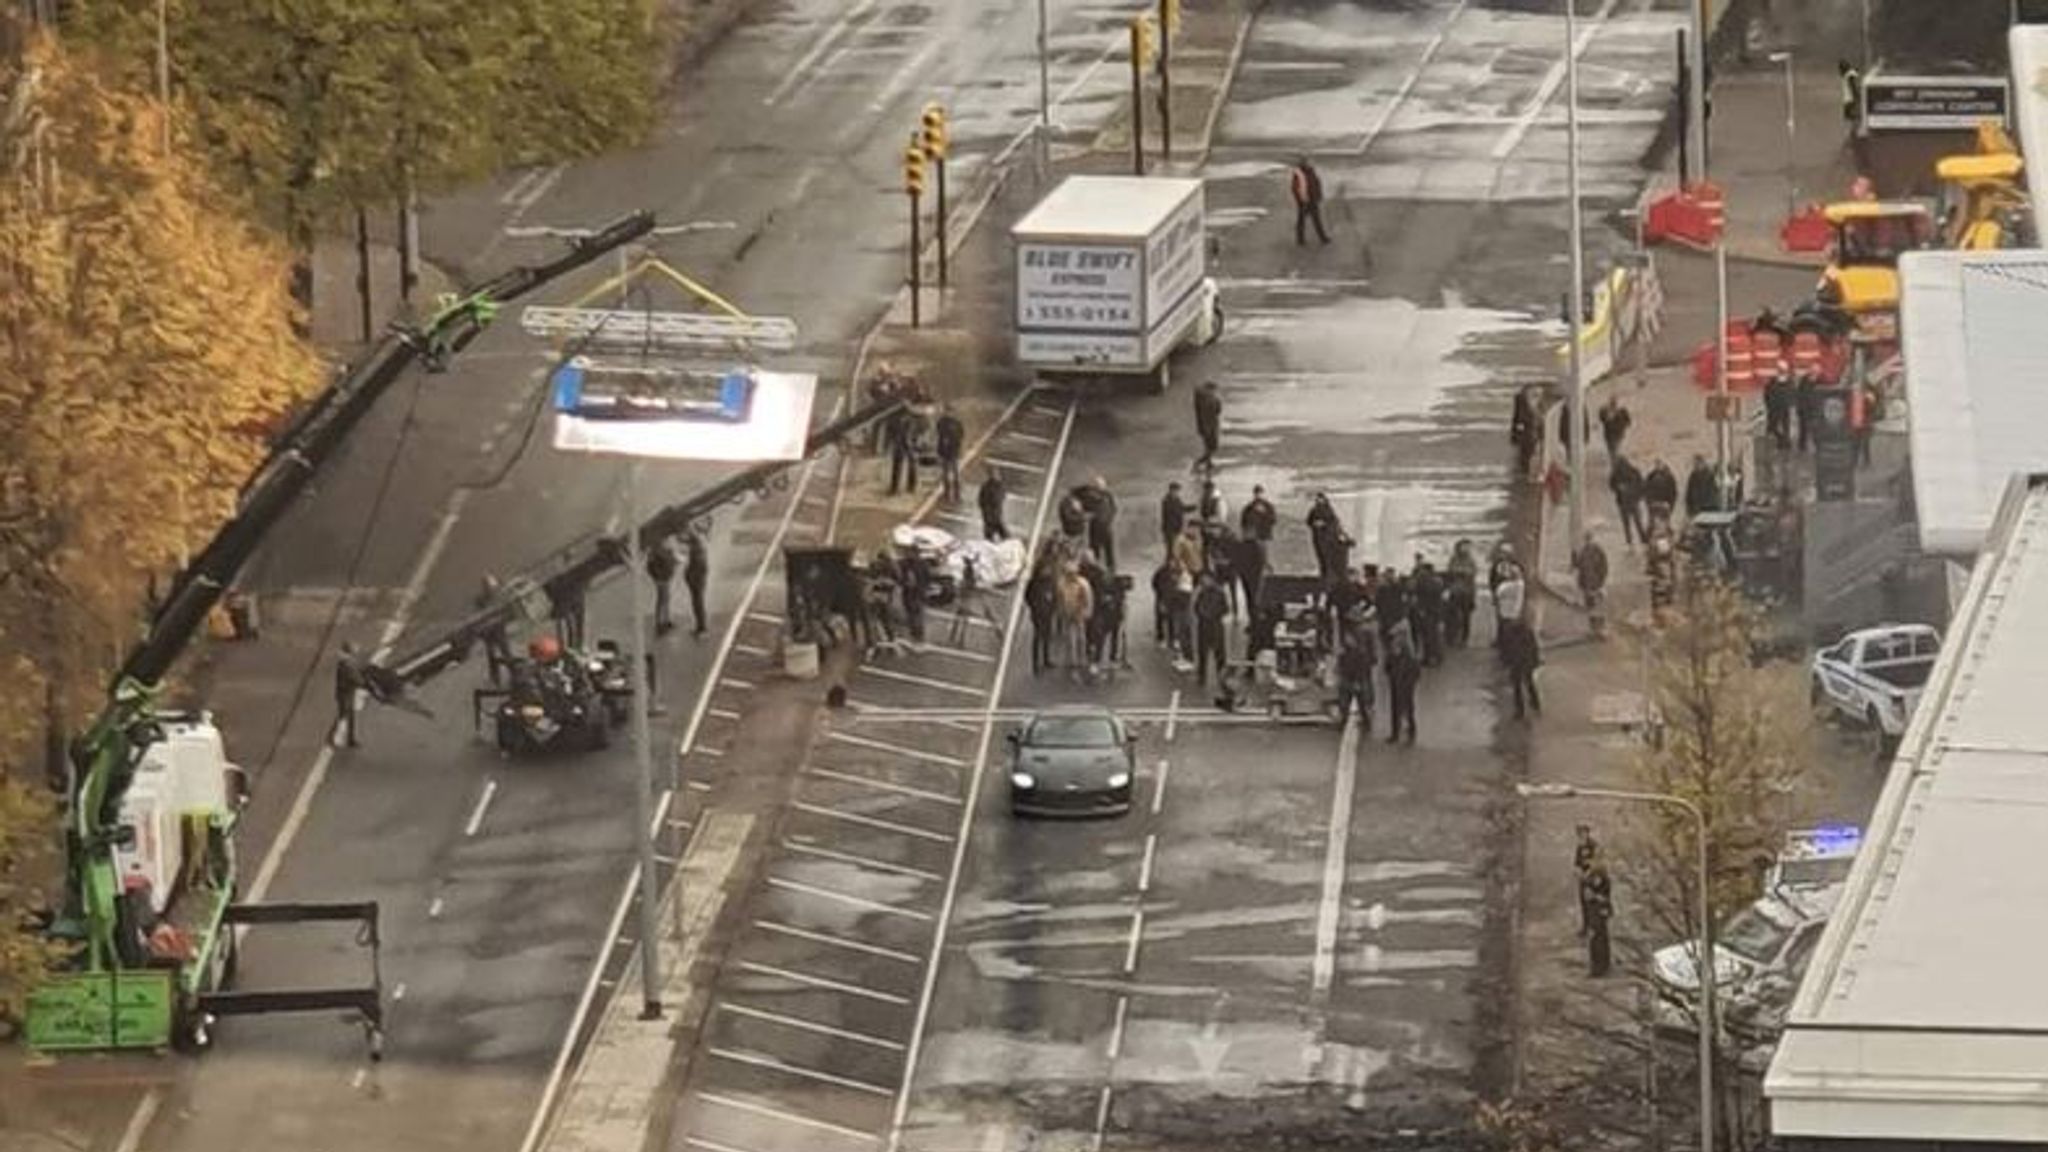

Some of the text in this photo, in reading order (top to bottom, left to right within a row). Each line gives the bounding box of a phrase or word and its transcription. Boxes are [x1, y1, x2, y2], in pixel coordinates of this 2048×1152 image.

[1025, 250, 1135, 269] BLUE SWIFT
[1051, 273, 1107, 286] EXPRESS
